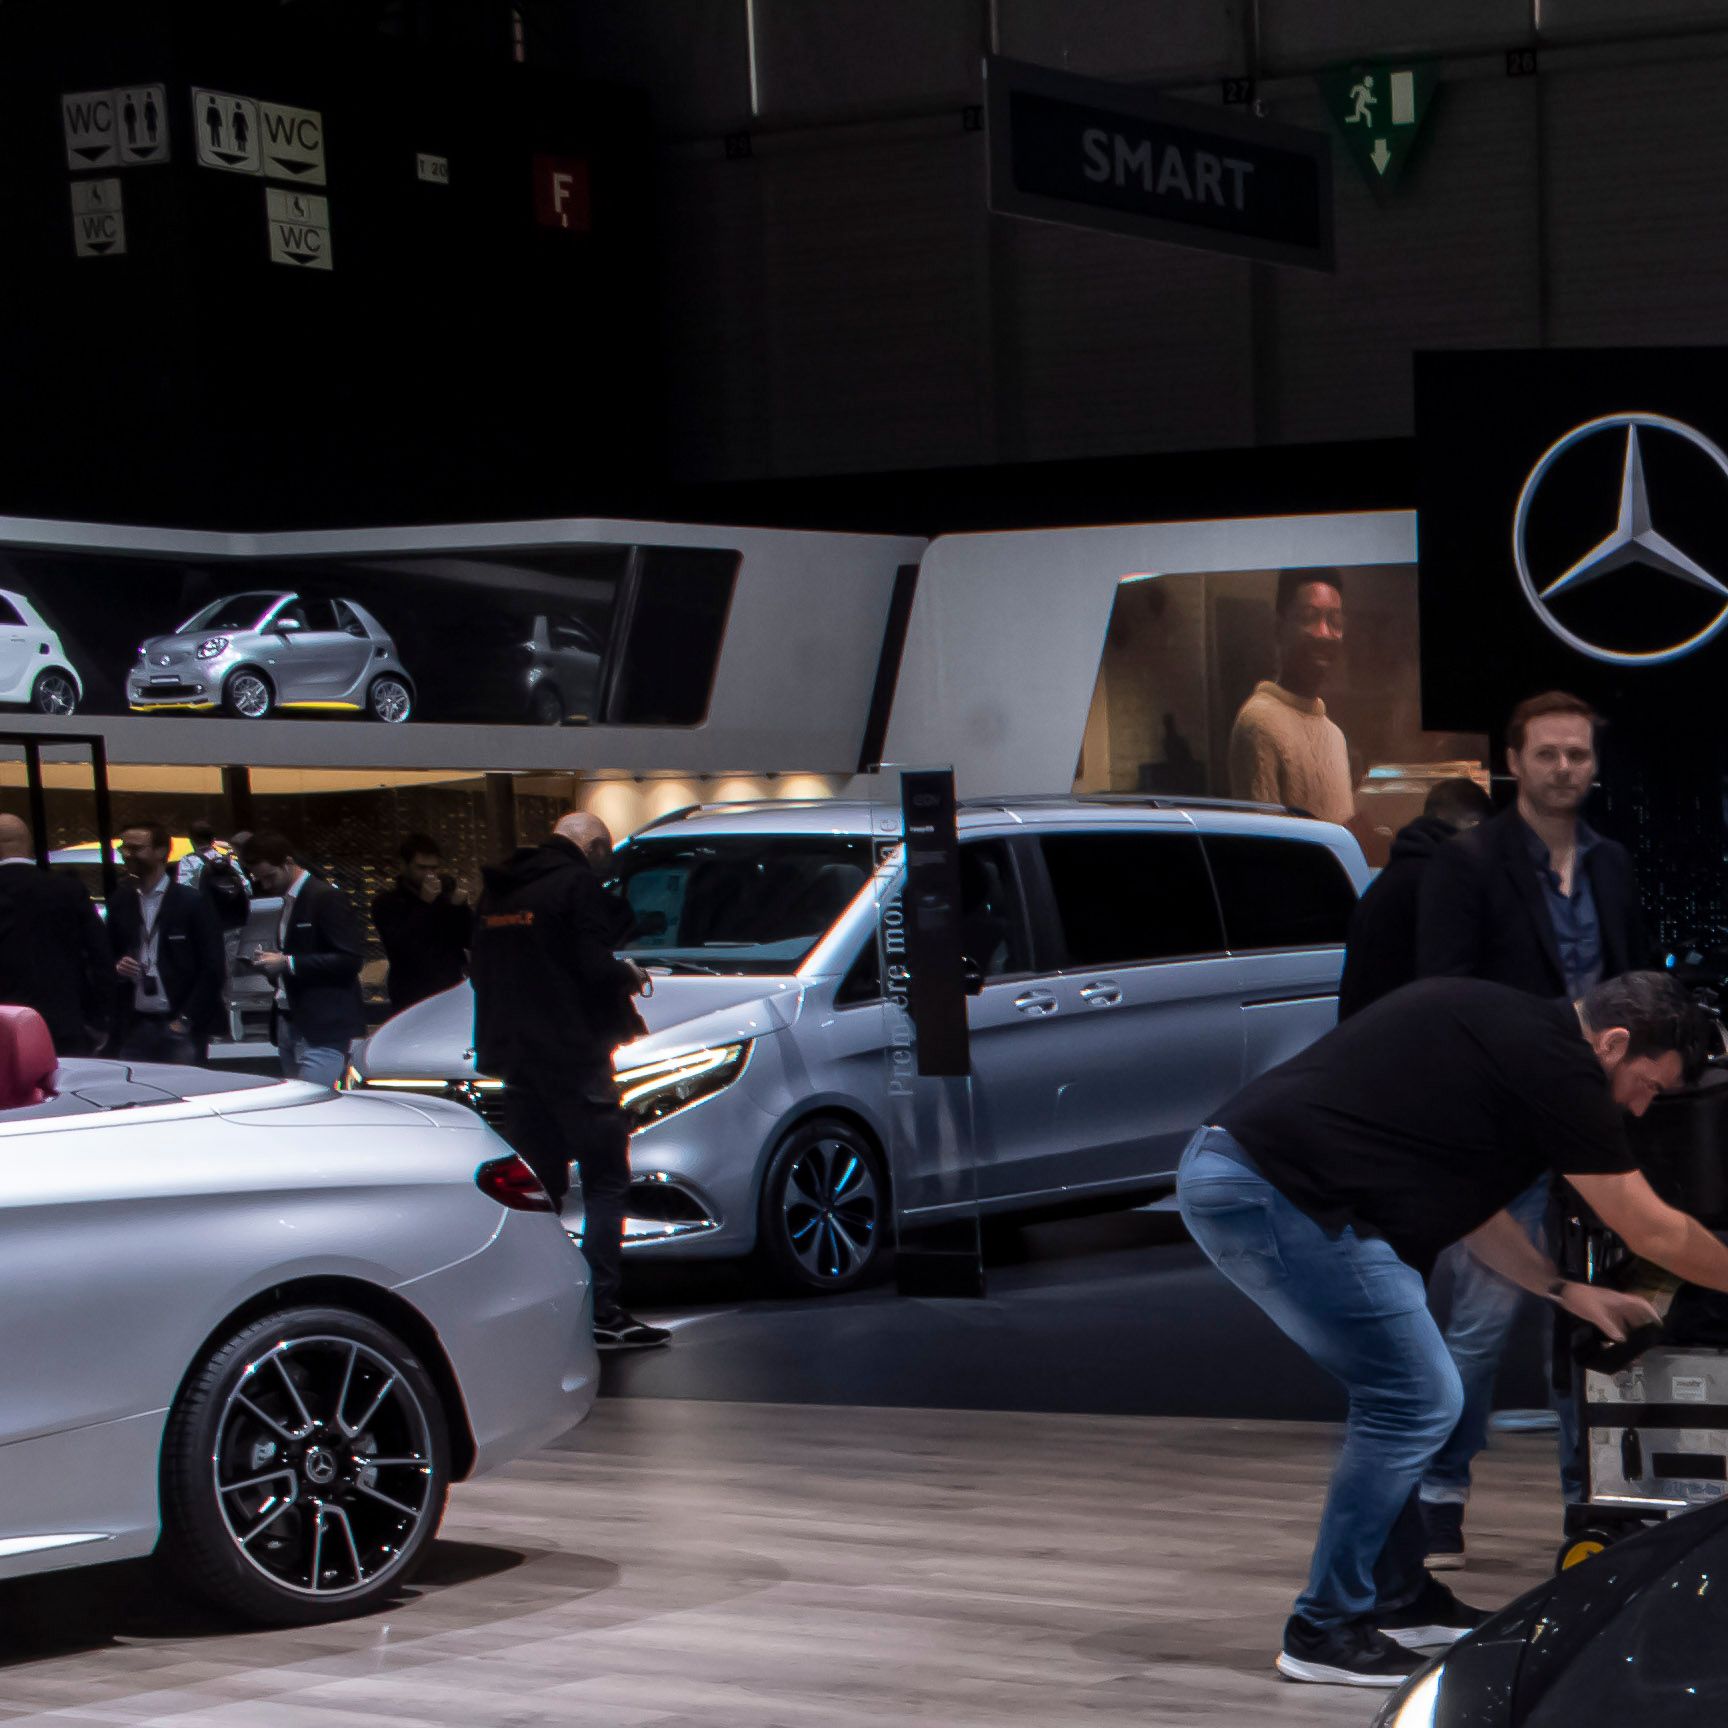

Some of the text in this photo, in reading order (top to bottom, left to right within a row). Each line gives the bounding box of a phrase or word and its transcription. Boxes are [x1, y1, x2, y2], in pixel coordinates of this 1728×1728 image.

[1226, 80, 1250, 102] 27
[66, 101, 113, 139] WC
[264, 111, 321, 151] WC
[1080, 127, 1256, 213] SMART
[553, 172, 574, 213] F
[82, 214, 117, 241] WC
[279, 224, 322, 253] WC
